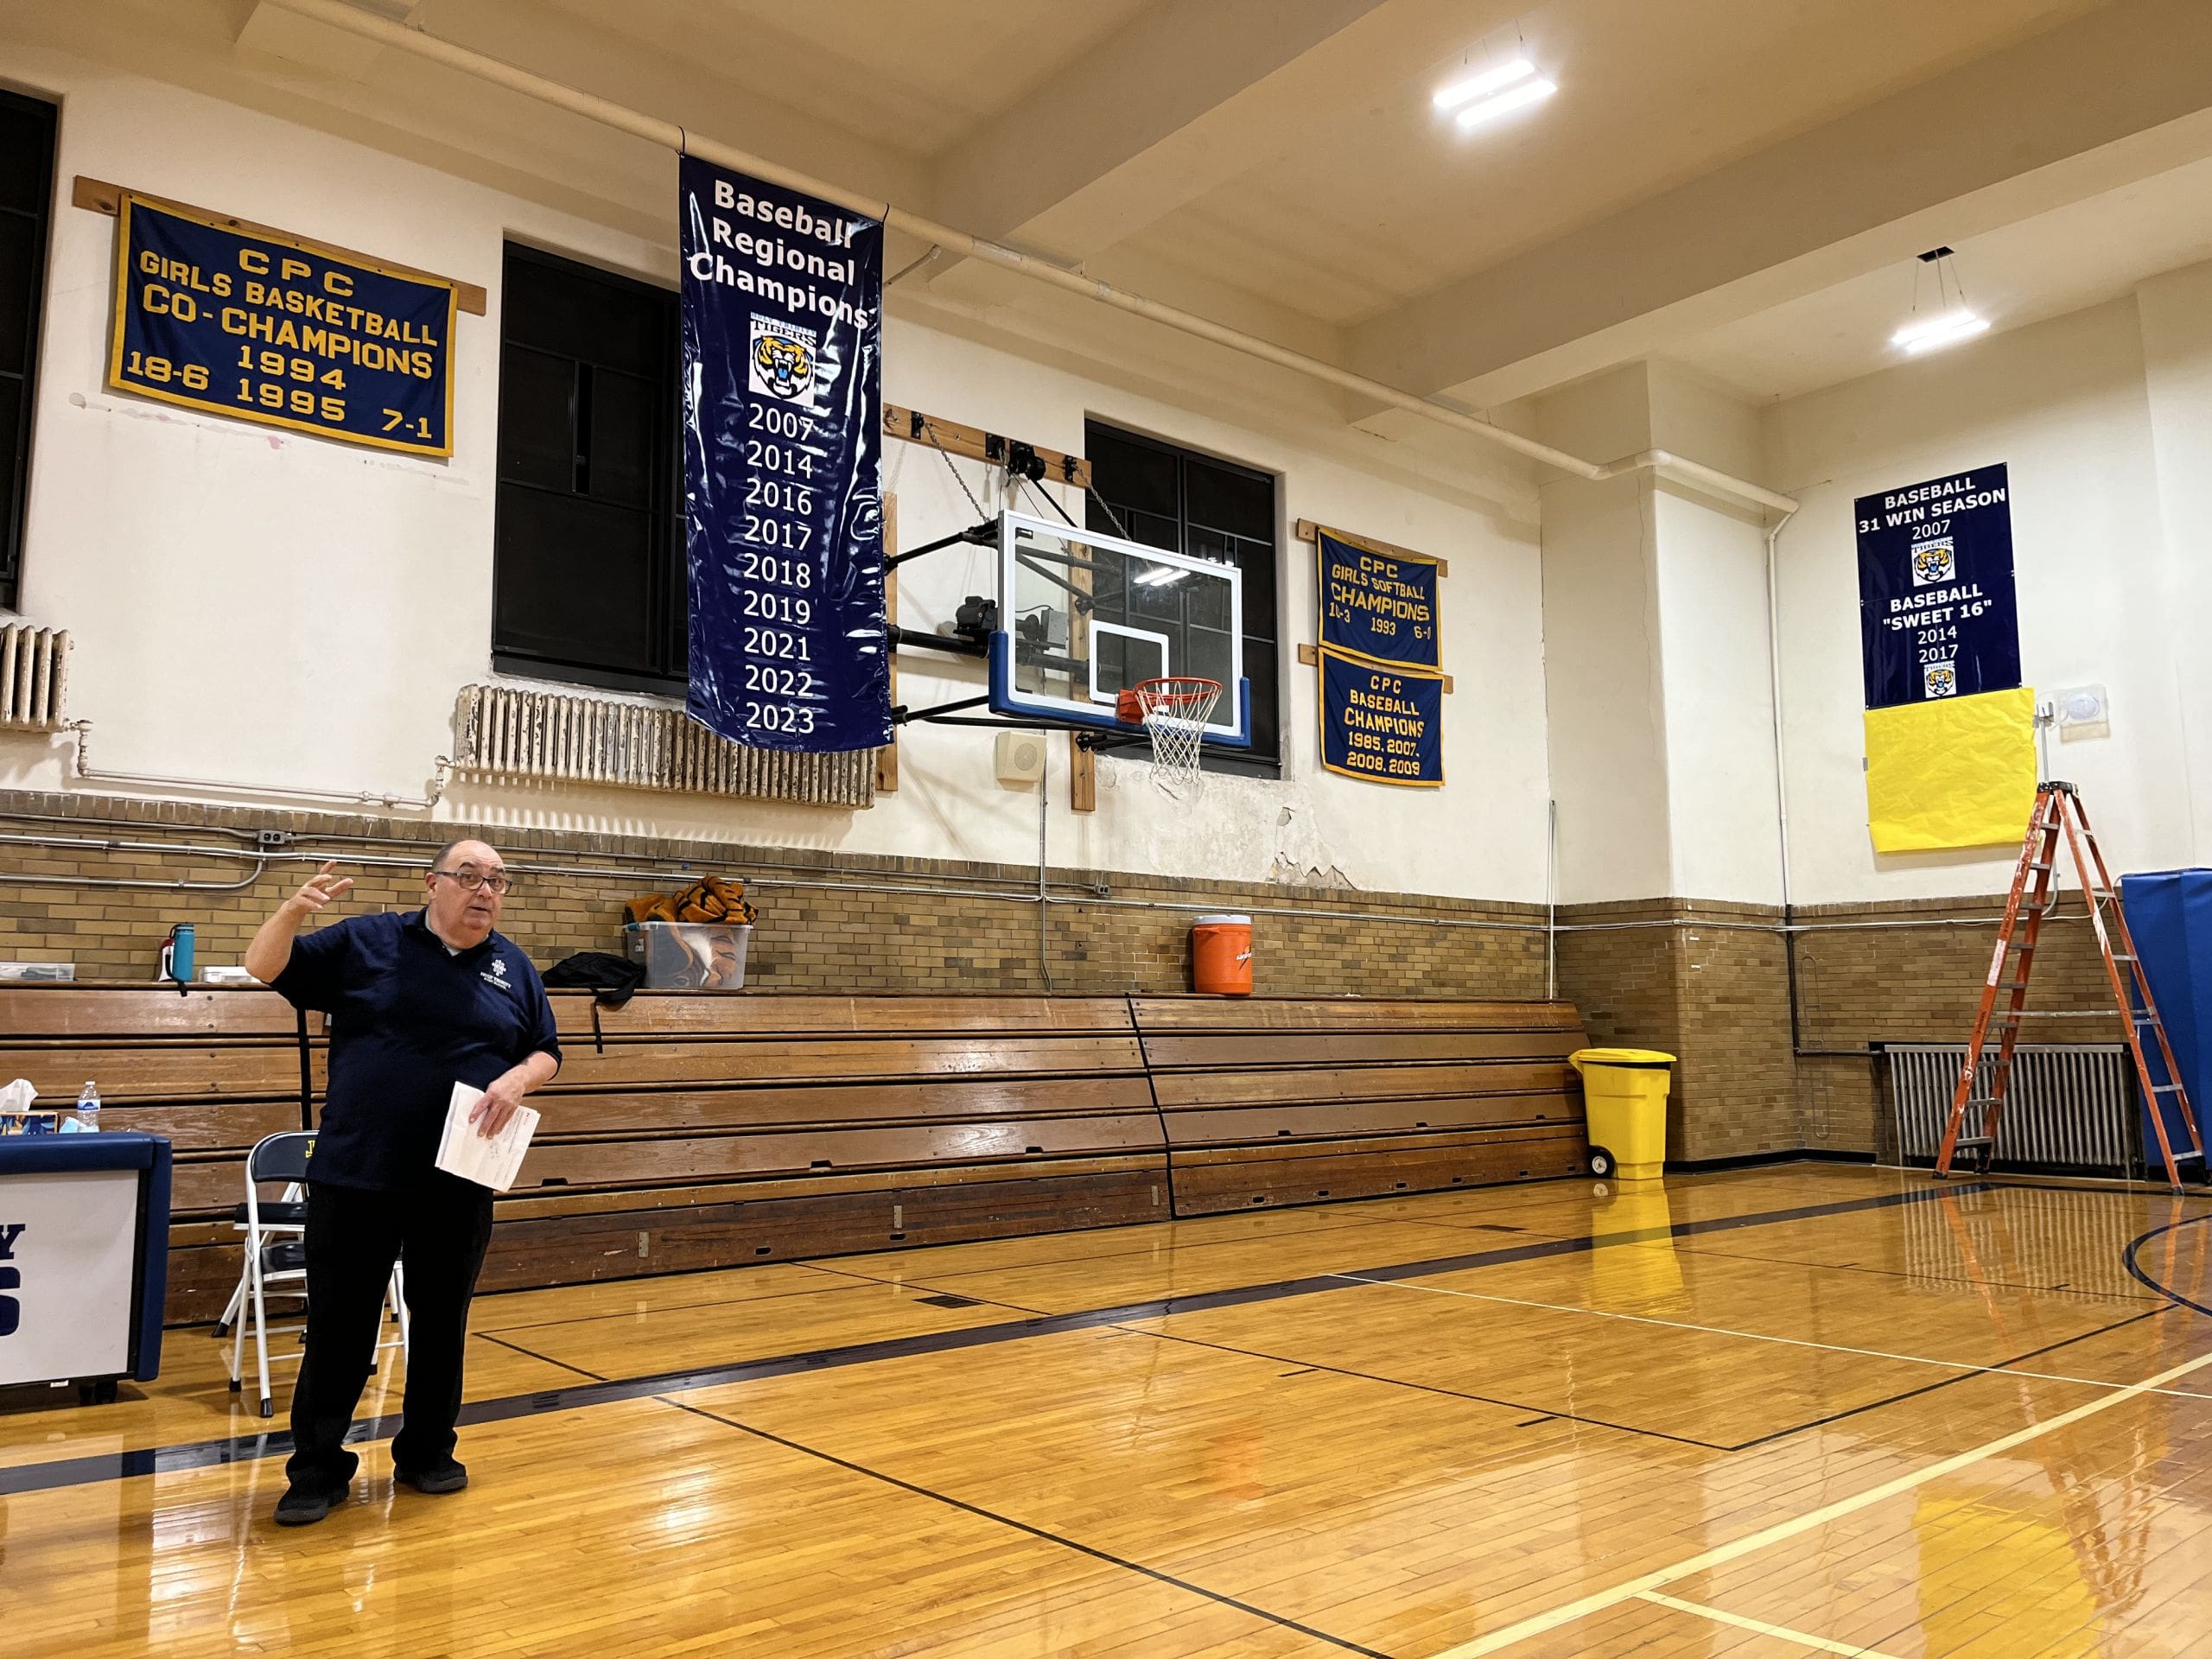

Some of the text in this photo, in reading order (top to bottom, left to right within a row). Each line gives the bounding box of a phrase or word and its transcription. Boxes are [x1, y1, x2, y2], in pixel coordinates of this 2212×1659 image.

[715, 179, 851, 249] Baseball
[712, 217, 855, 286] Regional
[140, 250, 437, 346] GIRLS BASKETBALL
[689, 251, 868, 329] Champions
[750, 319, 816, 347] TIGERS
[238, 345, 346, 390] 1994
[128, 351, 432, 438] 18-6 1995 7-1
[748, 404, 814, 442] 2007
[747, 441, 813, 480] 2014
[746, 478, 812, 515] 2016
[1859, 488, 2005, 533] 31 WIN SEASON
[1885, 477, 1975, 510] BASEBALL
[745, 516, 812, 550] 2017
[1912, 519, 1950, 540] 2007
[744, 553, 810, 588] 2018
[1332, 563, 1425, 600] GIRLS SOFTBALL
[1360, 556, 1398, 578] CPC
[744, 590, 810, 625] 2019
[1331, 582, 1430, 621] CHAMPIONS
[1891, 583, 1983, 613] BASEBALL
[1371, 617, 1395, 636] 1993
[1883, 600, 1992, 631] "SWEET 16"
[744, 627, 810, 661] 2021
[1917, 626, 1957, 645] 2014
[1919, 645, 1958, 663] 2017
[745, 664, 814, 699] 2022
[746, 702, 814, 734] 2023
[1350, 690, 1420, 715] BASEBALL
[1344, 707, 1424, 738] CHAMPIONS
[1389, 759, 1421, 775] 2009
